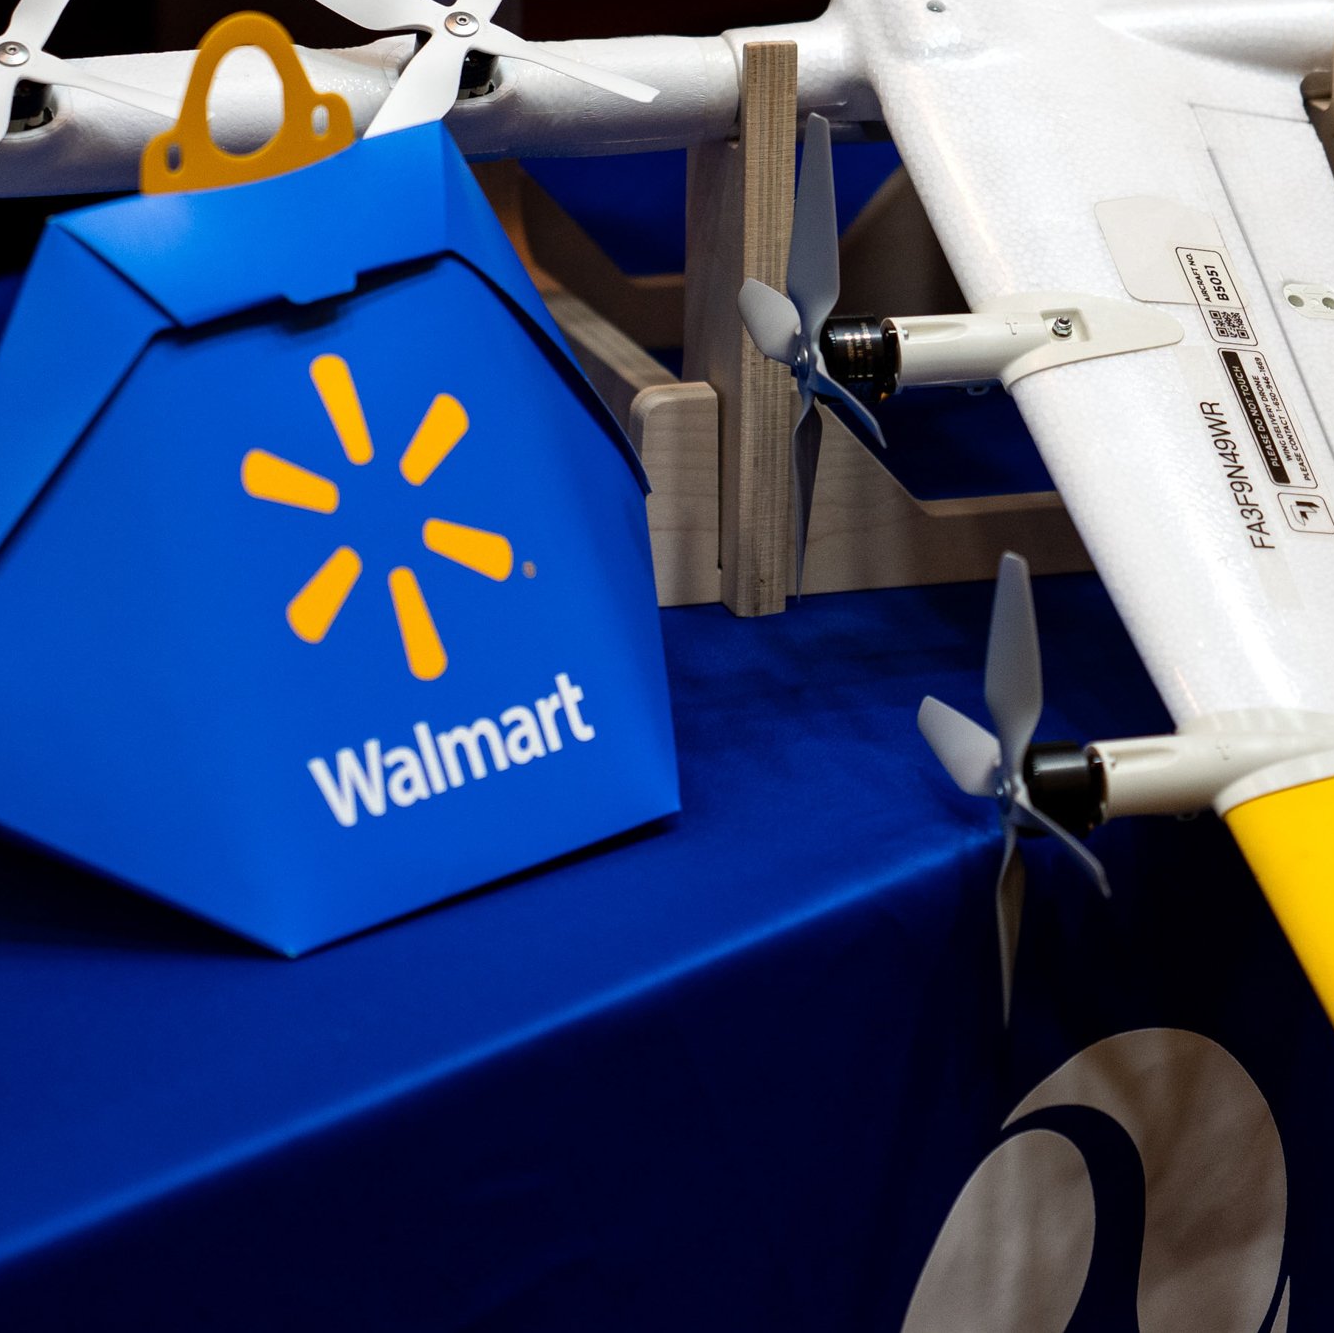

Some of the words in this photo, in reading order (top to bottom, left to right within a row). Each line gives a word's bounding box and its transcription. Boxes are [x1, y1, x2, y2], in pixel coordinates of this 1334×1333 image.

[1185, 253, 1196, 268] NO.
[1193, 269, 1212, 303] AIRCRAFT
[1203, 264, 1230, 301] B5051
[1231, 365, 1253, 396] TOUCH
[1252, 375, 1269, 402] DRONE
[1244, 397, 1260, 417] NOT
[1263, 401, 1284, 439] DELIVERY
[1252, 417, 1267, 433] DO
[1277, 415, 1299, 451] CONTACT
[1260, 433, 1281, 467] PLEASE
[1278, 439, 1293, 462] WING
[1199, 401, 1276, 550] FA3F9N49WR
[1292, 451, 1312, 482] PLEASE
[307, 672, 596, 827] Walmart
